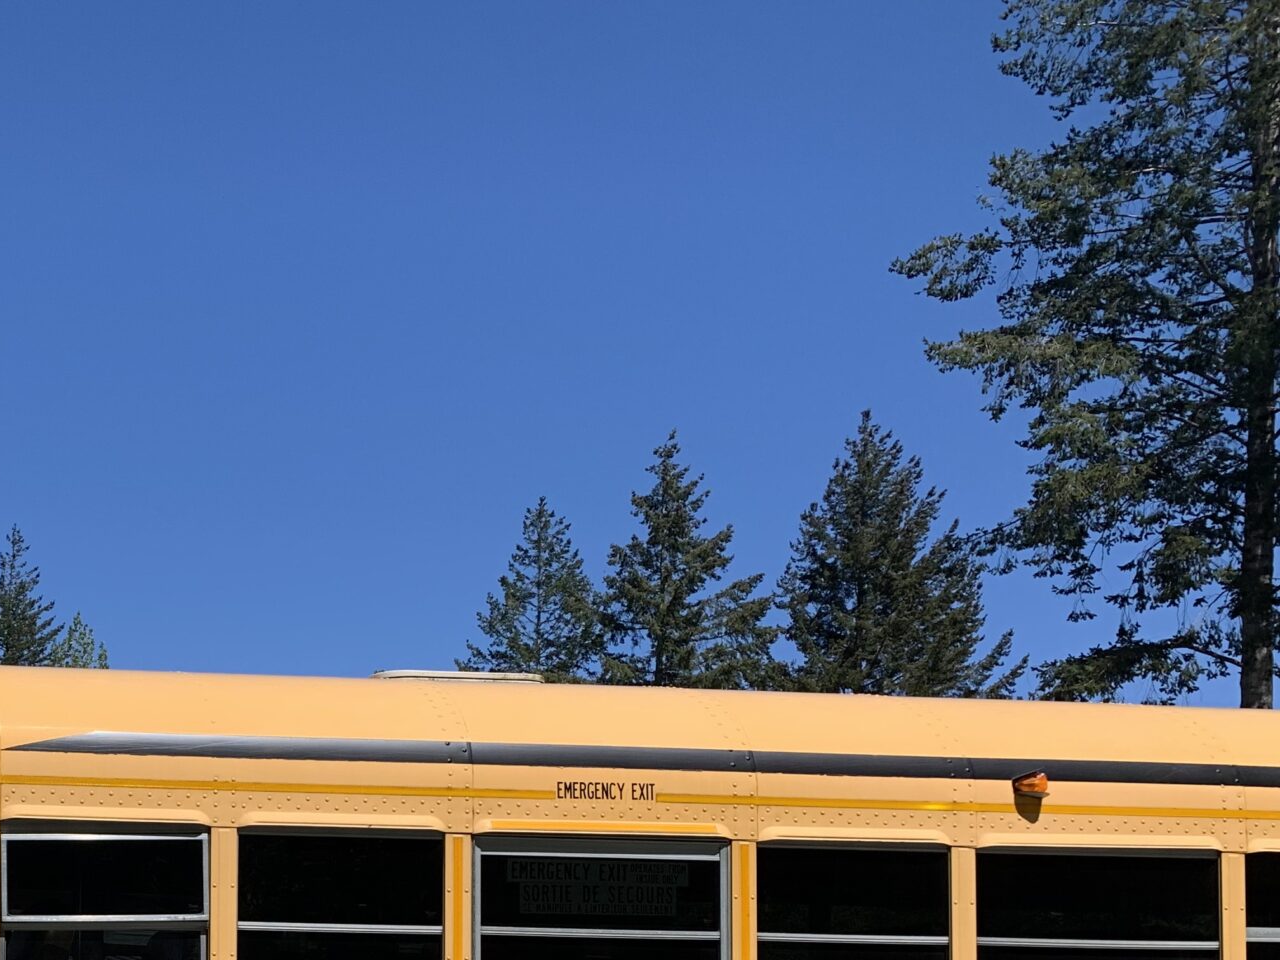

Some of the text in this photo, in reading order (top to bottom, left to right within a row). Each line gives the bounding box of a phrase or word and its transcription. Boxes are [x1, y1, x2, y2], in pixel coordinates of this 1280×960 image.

[557, 781, 655, 800] EMERGENCY EXIT
[511, 861, 629, 882] EMERGENCY EXIT
[522, 885, 674, 904] SORTIE DE SECOURS
